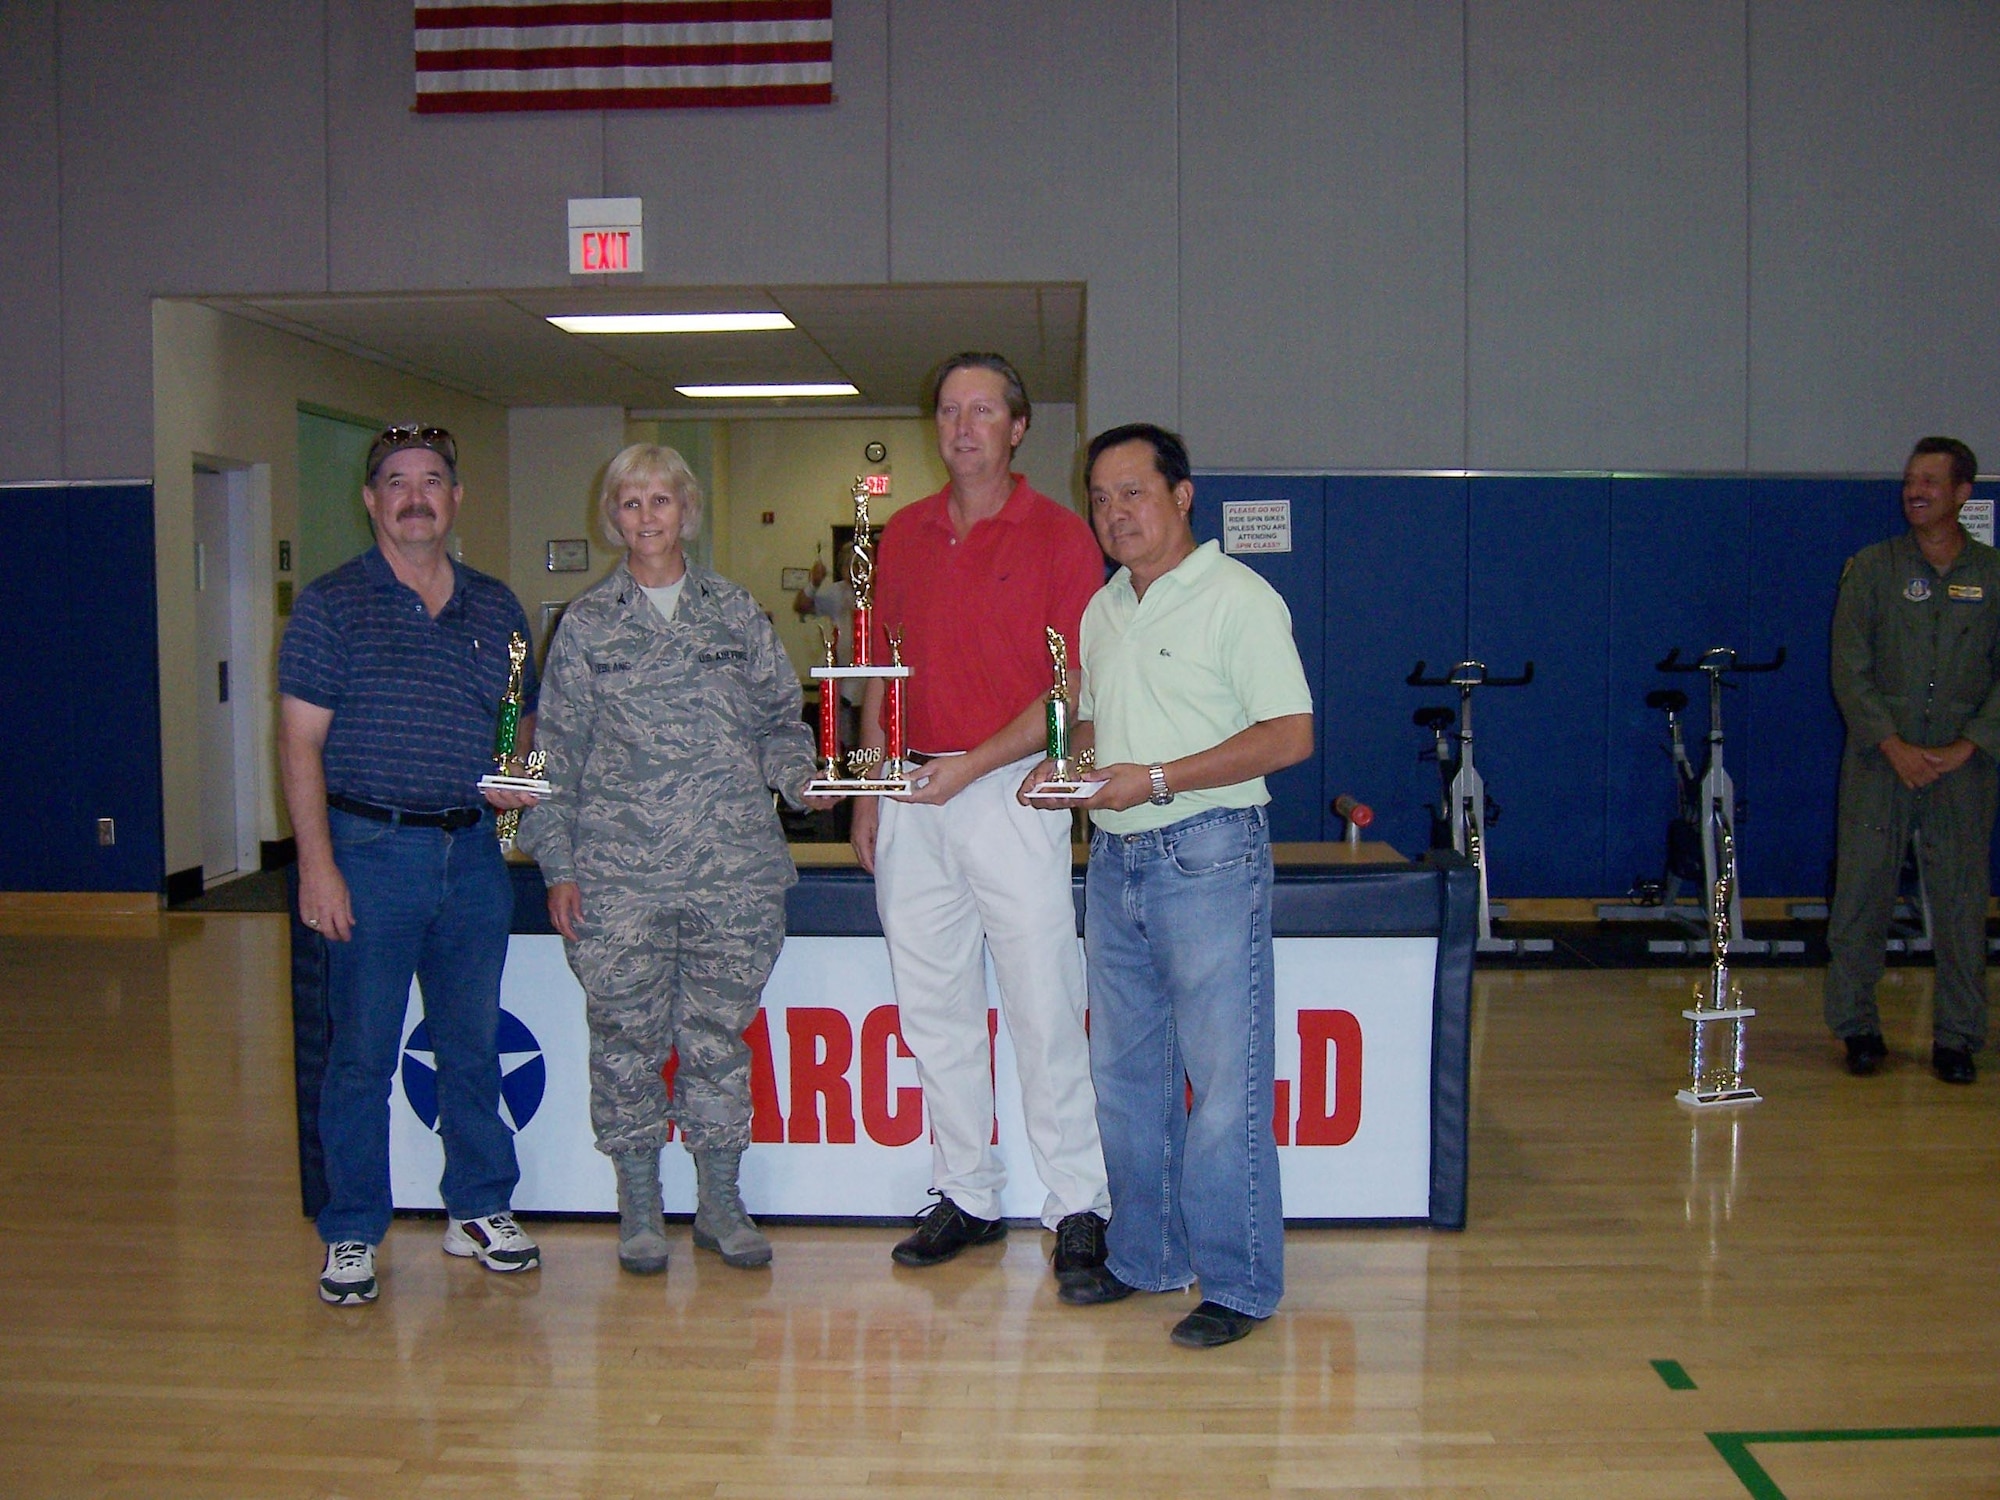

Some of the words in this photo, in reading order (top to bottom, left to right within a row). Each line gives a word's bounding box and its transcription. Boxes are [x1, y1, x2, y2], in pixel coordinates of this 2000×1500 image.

[583, 232, 630, 270] EXIT
[528, 750, 547, 767] 08
[847, 747, 881, 766] 2008
